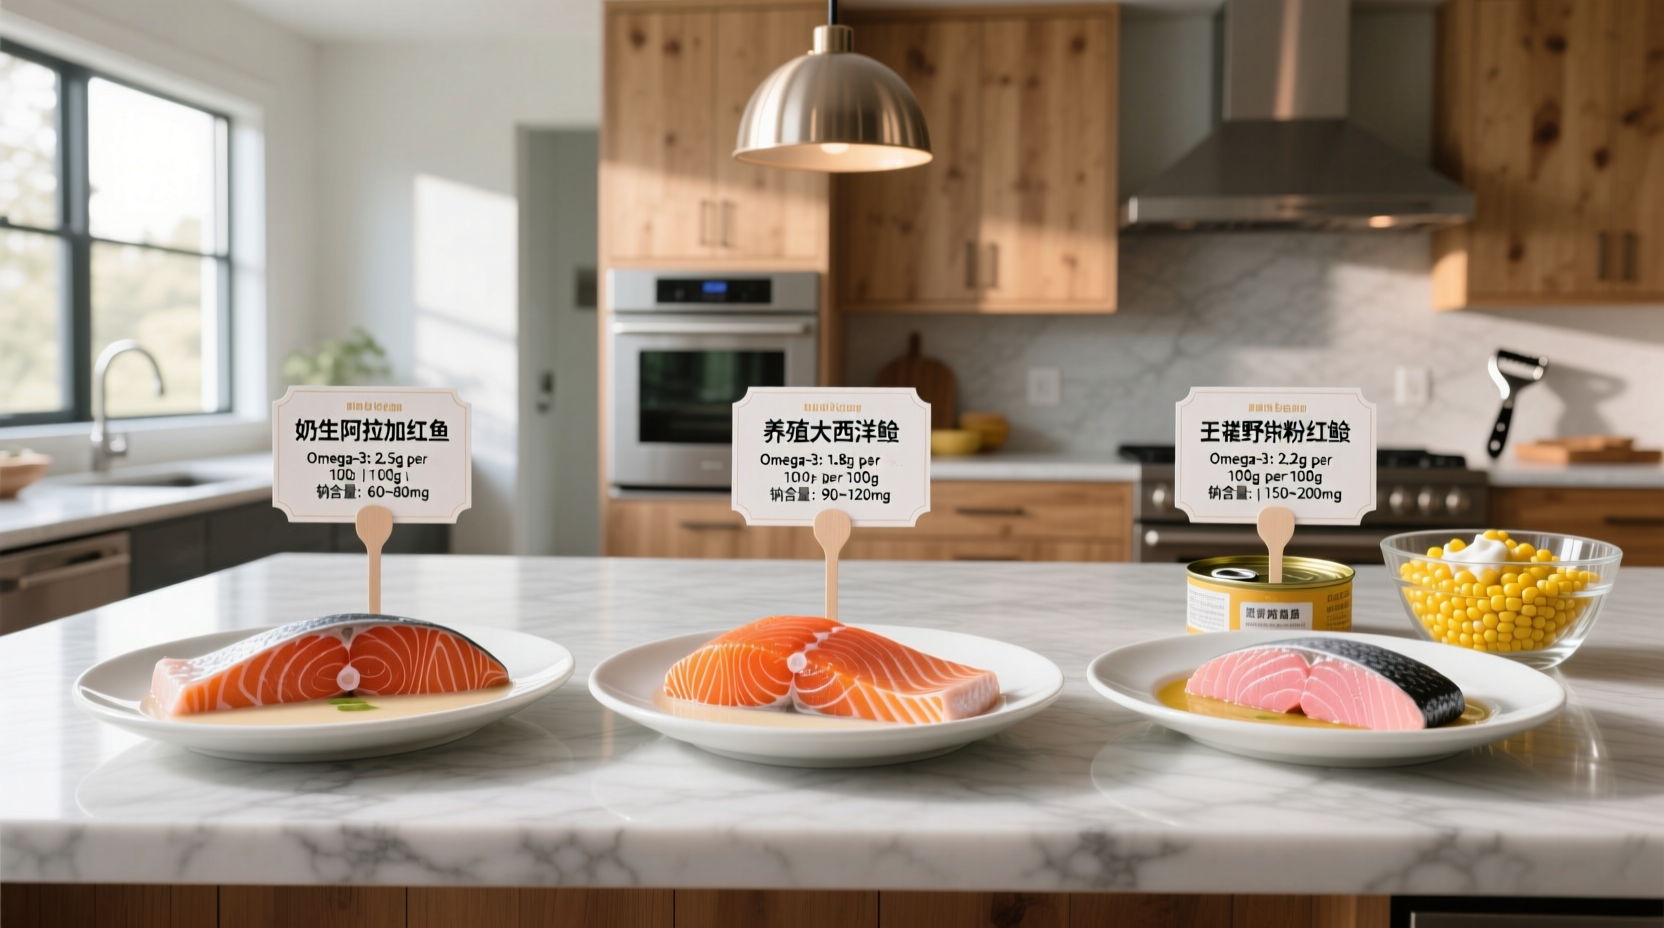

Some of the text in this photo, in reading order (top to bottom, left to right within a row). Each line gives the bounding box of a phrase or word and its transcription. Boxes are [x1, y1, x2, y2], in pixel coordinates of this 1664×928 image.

[295, 418, 450, 443] 奶生阿拉加红鱼
[307, 452, 428, 469] Omega-3: 2.5g per
[760, 453, 823, 469] Omega-3:
[859, 456, 881, 470] per
[1209, 452, 1333, 469] Omega-3: 2.2g per
[846, 470, 879, 487] 100g
[1227, 469, 1323, 485] 100g per 100g
